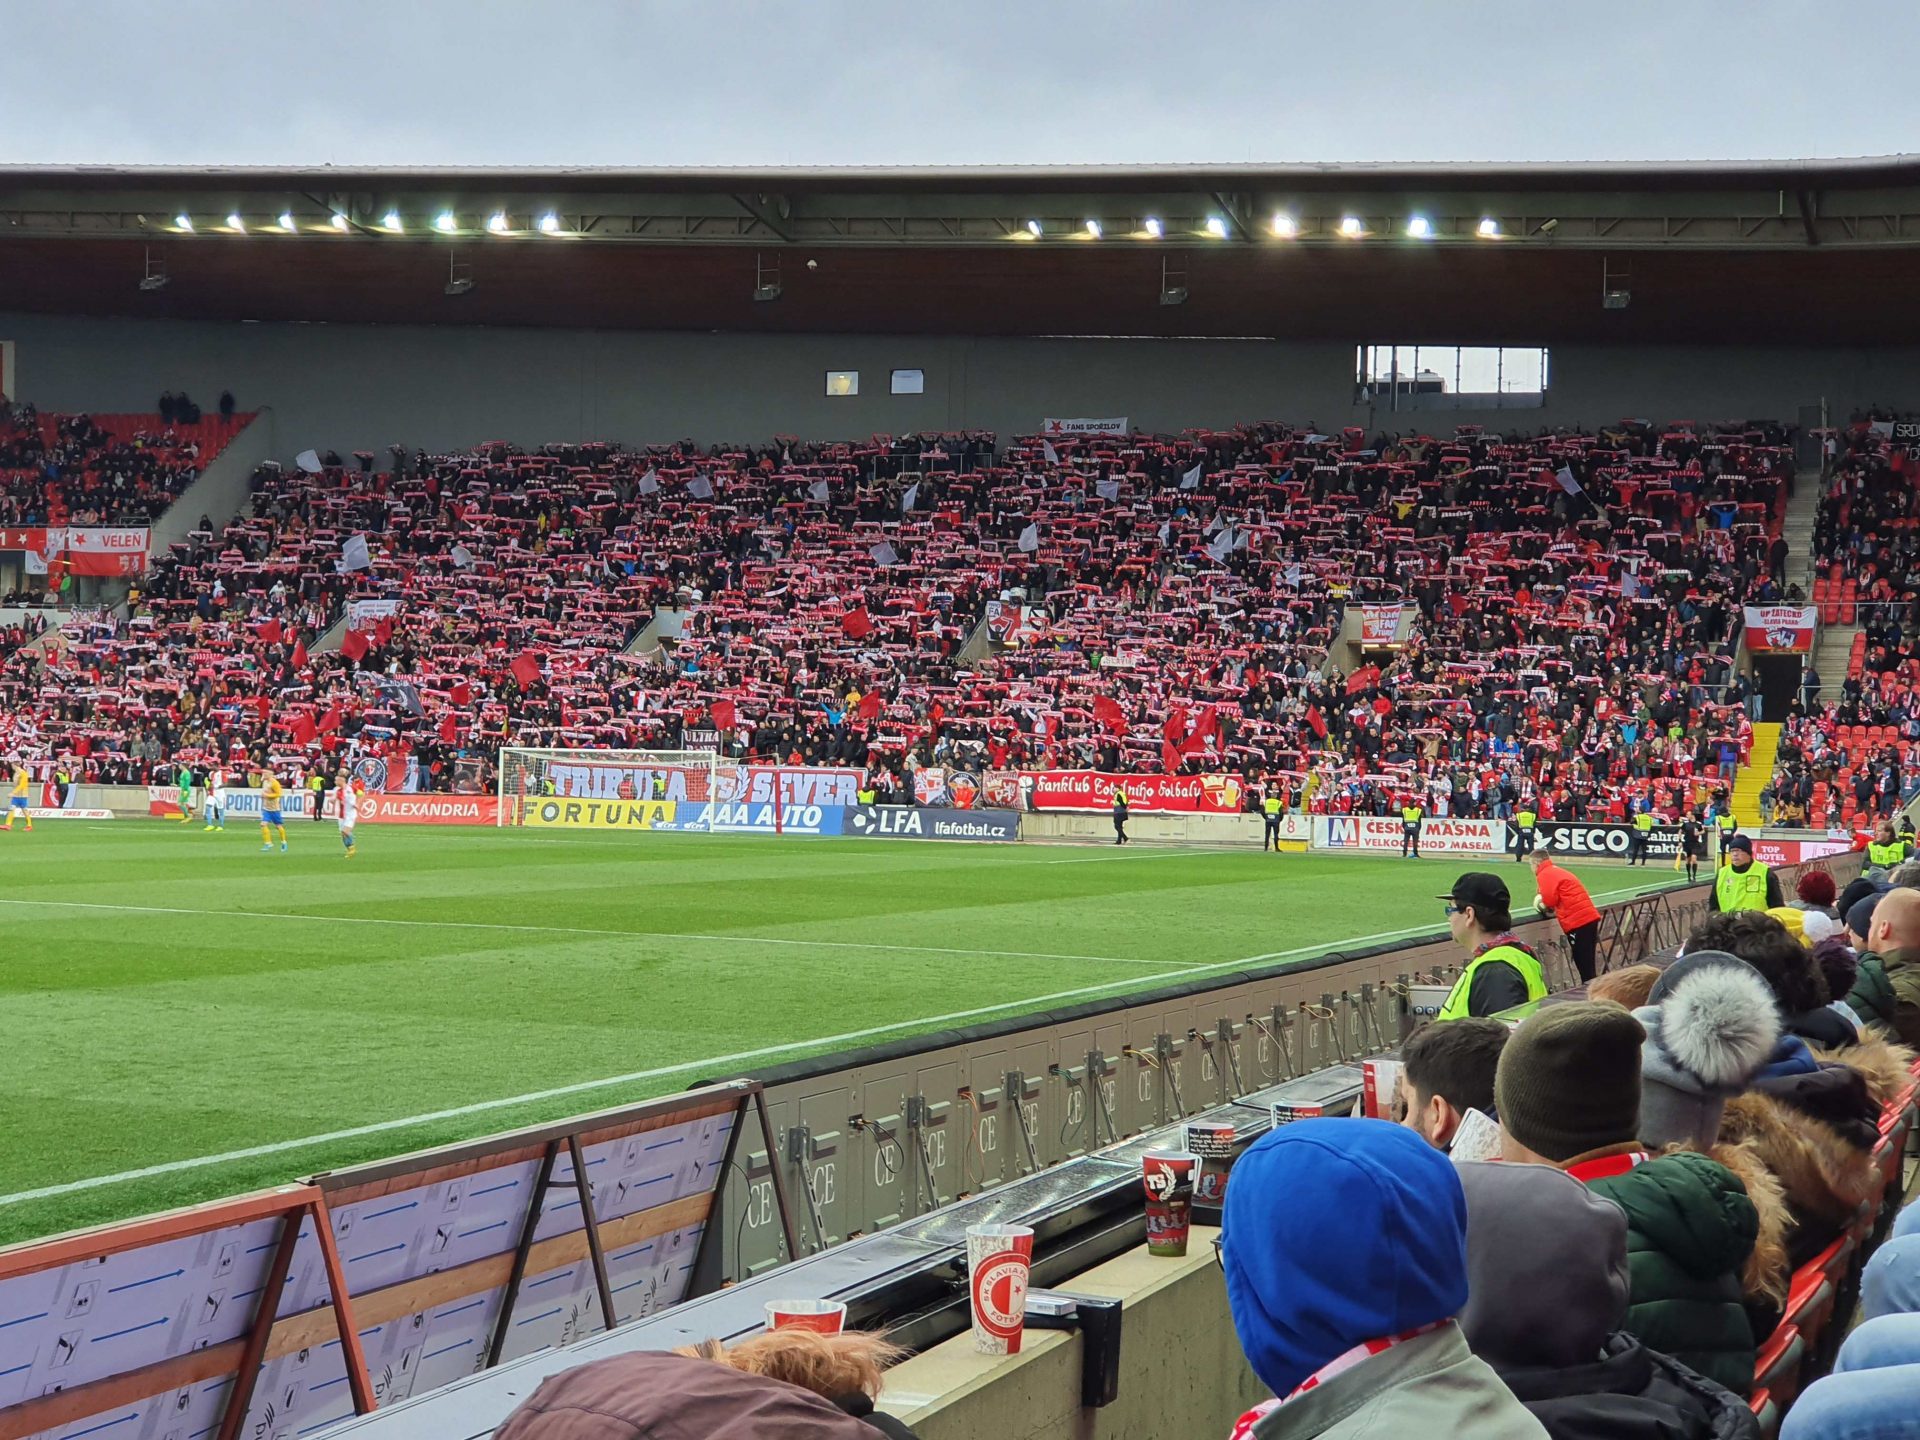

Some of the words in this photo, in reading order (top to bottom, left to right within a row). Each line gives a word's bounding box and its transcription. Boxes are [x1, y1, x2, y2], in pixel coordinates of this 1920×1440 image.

[1066, 423, 1084, 431] FANS
[1086, 422, 1121, 431] SPOŘILOV
[102, 531, 142, 548] VELEŇ
[684, 731, 719, 742] ULTRA
[751, 772, 858, 806] SEVER
[380, 802, 479, 817] ALEXANDRIA
[523, 801, 665, 824] FORTUNA
[697, 803, 749, 825] AAA
[754, 805, 823, 827] AUTO
[879, 810, 922, 834] LFA
[935, 821, 1006, 837] lfafotbal.cz
[1366, 818, 1405, 835] ČESK
[1426, 822, 1491, 837] MASNA
[1450, 841, 1492, 850] MASEM
[1553, 828, 1630, 852] SECO
[1760, 845, 1780, 854] TOP
[1756, 853, 1787, 861] HOTEL
[1138, 1070, 1151, 1102] CE
[1067, 1090, 1082, 1125] CE
[979, 1115, 997, 1153] CE
[927, 1130, 946, 1171] CE
[874, 1145, 895, 1187] CE
[812, 1163, 835, 1207] CE
[747, 1181, 773, 1229] CE
[985, 1266, 1020, 1288] SLAVIA
